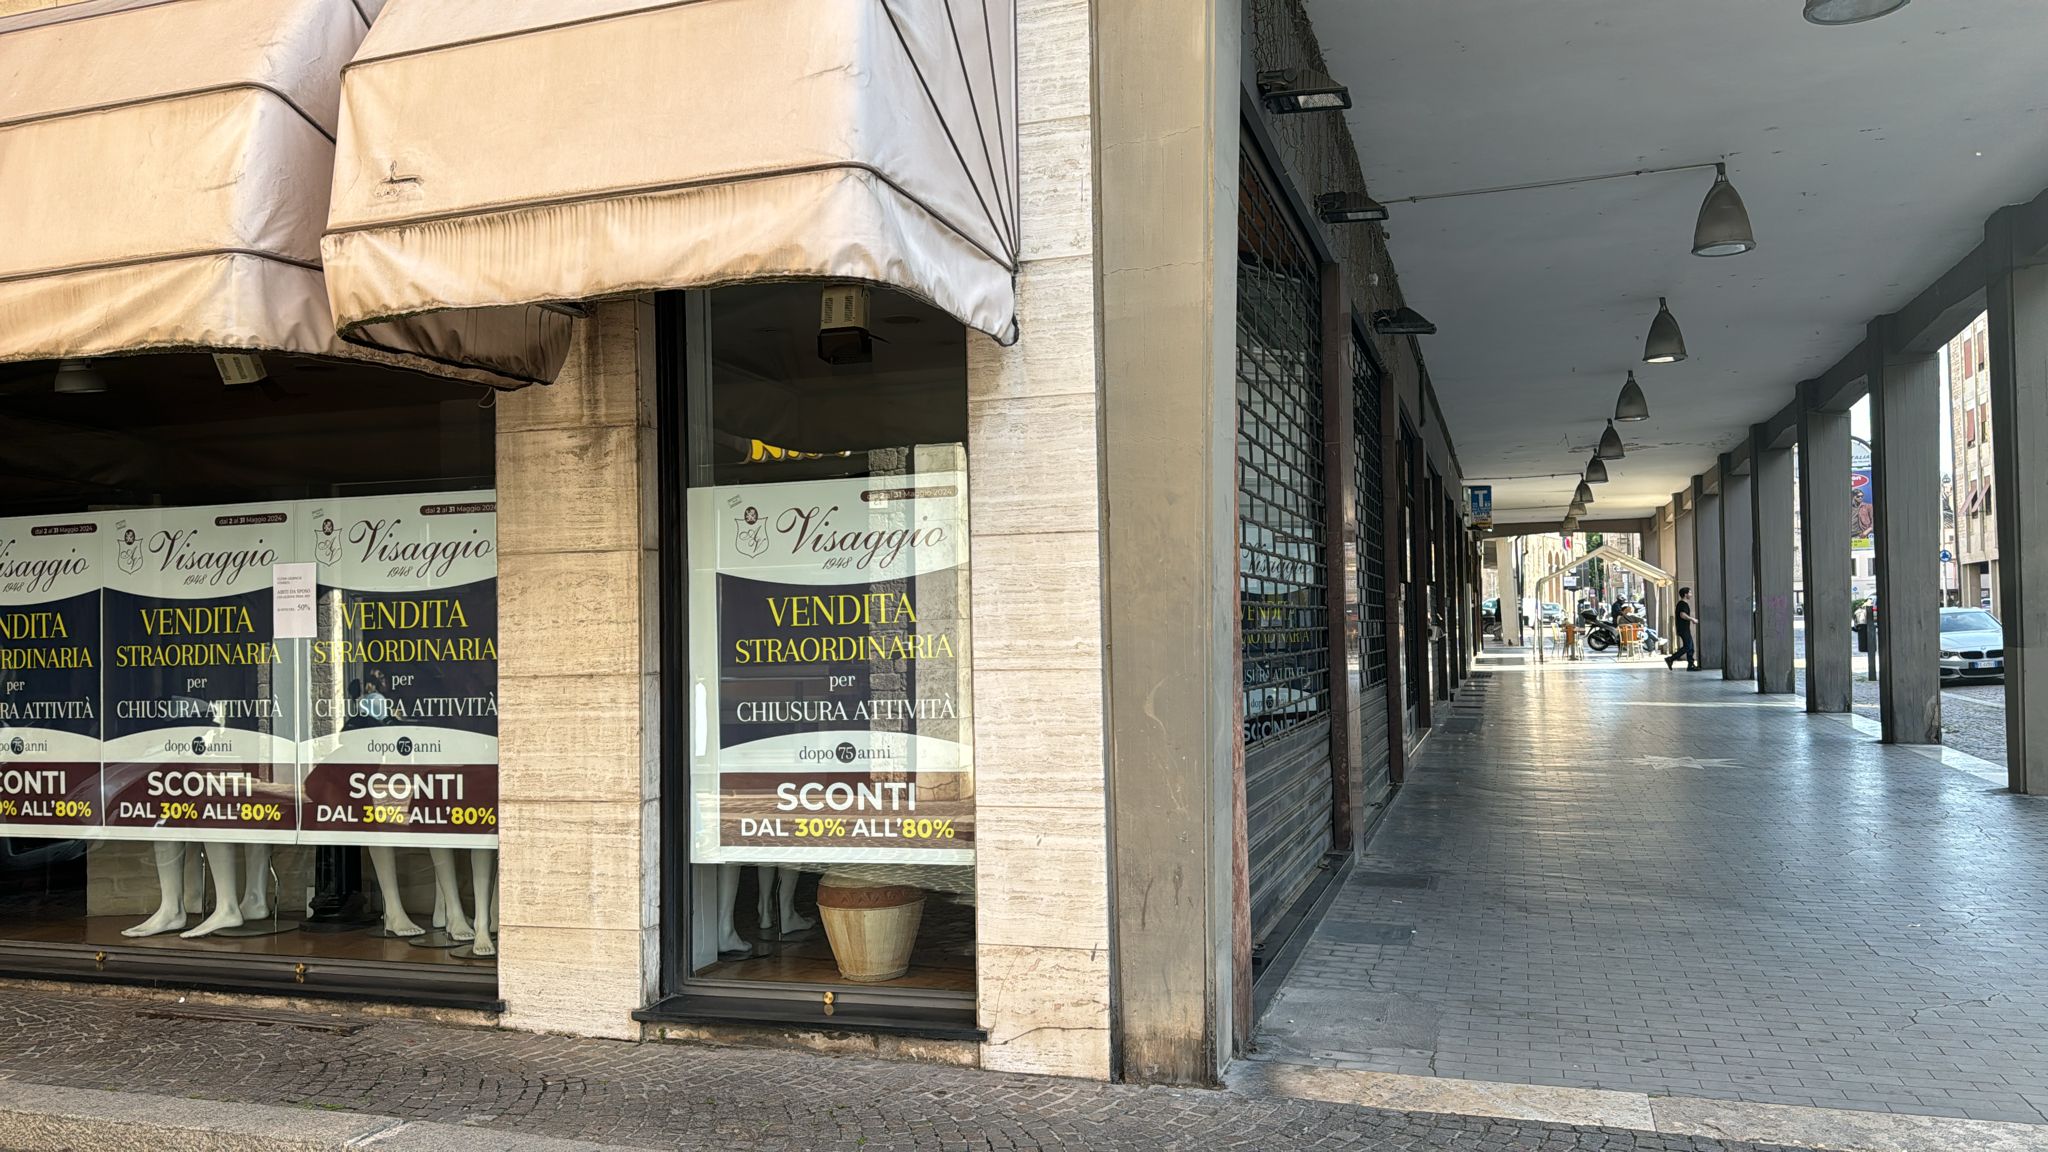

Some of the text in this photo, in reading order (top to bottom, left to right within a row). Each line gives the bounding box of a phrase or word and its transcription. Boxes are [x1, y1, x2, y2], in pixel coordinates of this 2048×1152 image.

[893, 490, 902, 498] 31
[903, 489, 931, 498] Maggio
[933, 488, 952, 496] 2024
[1474, 490, 1488, 507] T
[456, 505, 480, 513] Maggio
[776, 505, 948, 570] Visaggio
[149, 529, 279, 586] Visaggio
[349, 519, 494, 579] Visaggio
[386, 566, 413, 578] 1948
[822, 556, 852, 570] 1948
[3, 582, 25, 593] 1948
[183, 573, 207, 586] 1948
[341, 599, 468, 631] VENDITA
[767, 592, 918, 628] VENDITA
[140, 606, 255, 636] VENDITA
[116, 641, 283, 668] STRAORDINARIA
[314, 637, 497, 665] STRAORDINARIA
[735, 633, 954, 664] STRAORDINARIA
[6, 680, 25, 695] per
[186, 675, 208, 693] per
[391, 673, 414, 691] per
[829, 673, 856, 692] per
[23, 696, 95, 720] ATTIVITÀ
[116, 696, 283, 719] CHIUSURA ATTIVITÀ
[315, 692, 497, 718] CHIUSURA ATTIVITÀ
[736, 693, 957, 722] CHIUSURA ATTIVITÀ
[12, 739, 23, 751] 75
[26, 739, 48, 752] anni
[164, 738, 232, 756] dopo 75 anni
[367, 738, 441, 755] dopo 75 anni
[799, 744, 891, 763] dopo 75 anni
[0, 770, 66, 795] ONTI
[147, 771, 252, 797] SCONTI
[350, 772, 463, 800] SCONTI
[777, 781, 916, 811] SCONTI
[120, 802, 156, 819] DAL
[160, 802, 198, 820] 30%
[316, 804, 358, 823] DAL
[363, 805, 404, 824] 30%
[741, 817, 789, 838] DAL
[795, 817, 846, 838] 30%
